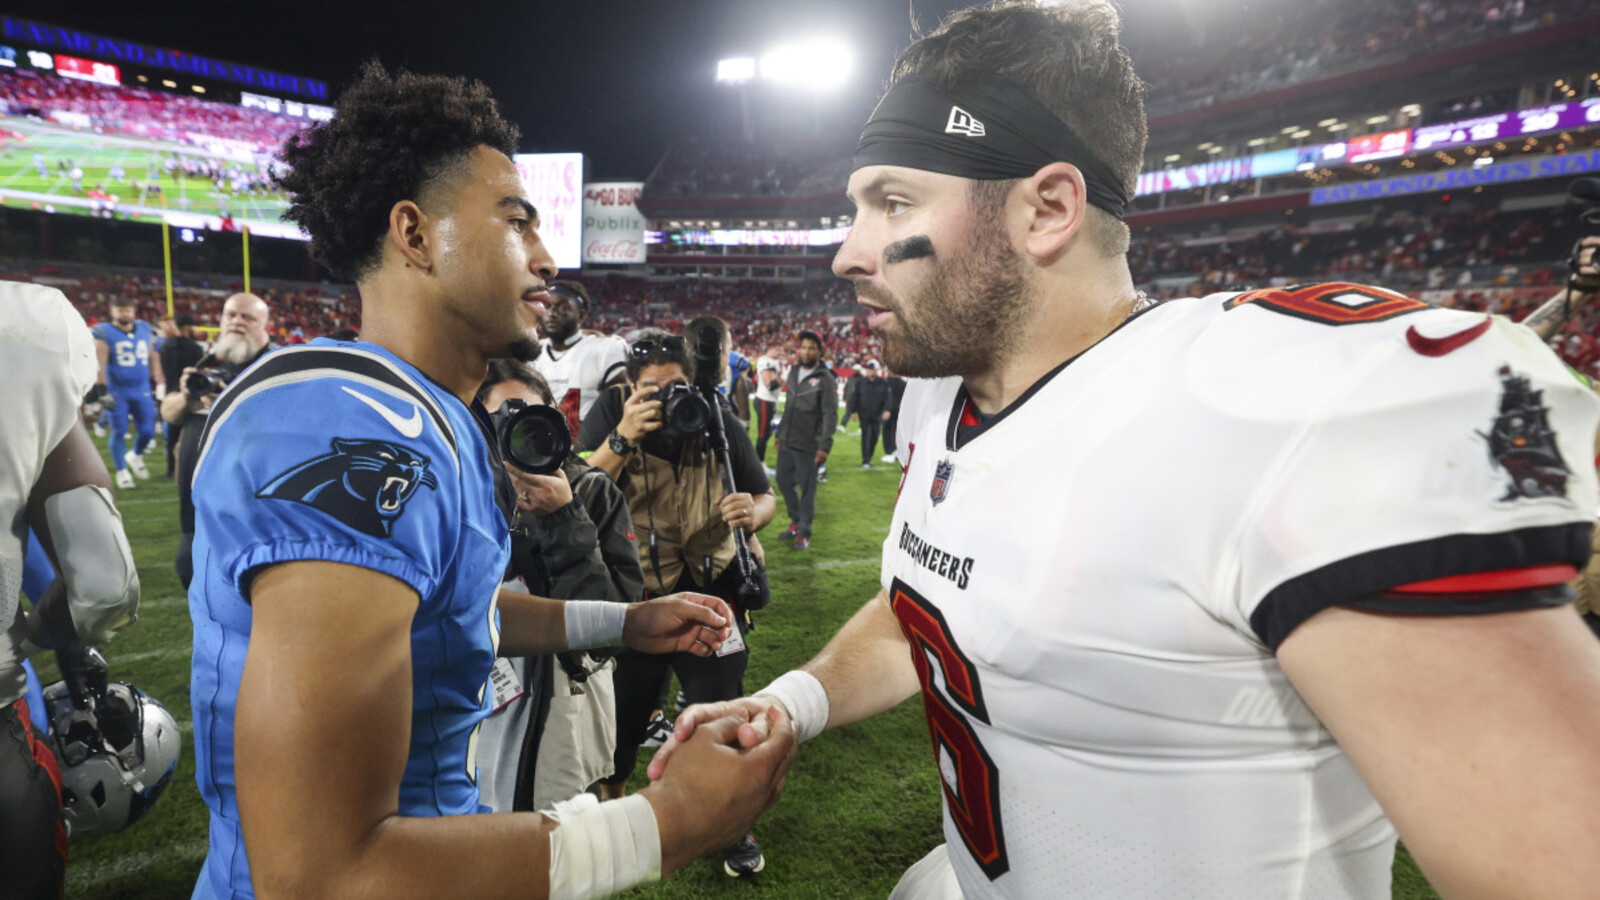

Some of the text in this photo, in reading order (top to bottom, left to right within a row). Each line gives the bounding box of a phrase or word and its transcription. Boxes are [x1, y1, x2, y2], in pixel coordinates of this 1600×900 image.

[4, 16, 145, 64] RAYMOND
[147, 48, 229, 80] JAMES
[230, 63, 326, 99] STADIUM
[600, 187, 616, 207] GO
[1310, 172, 1437, 206] RAYMOND
[1436, 161, 1532, 190] JAMES
[584, 215, 640, 231] Publix
[115, 338, 150, 367] 64
[898, 521, 975, 592] BUCCANEERS
[890, 576, 1009, 881] 6
